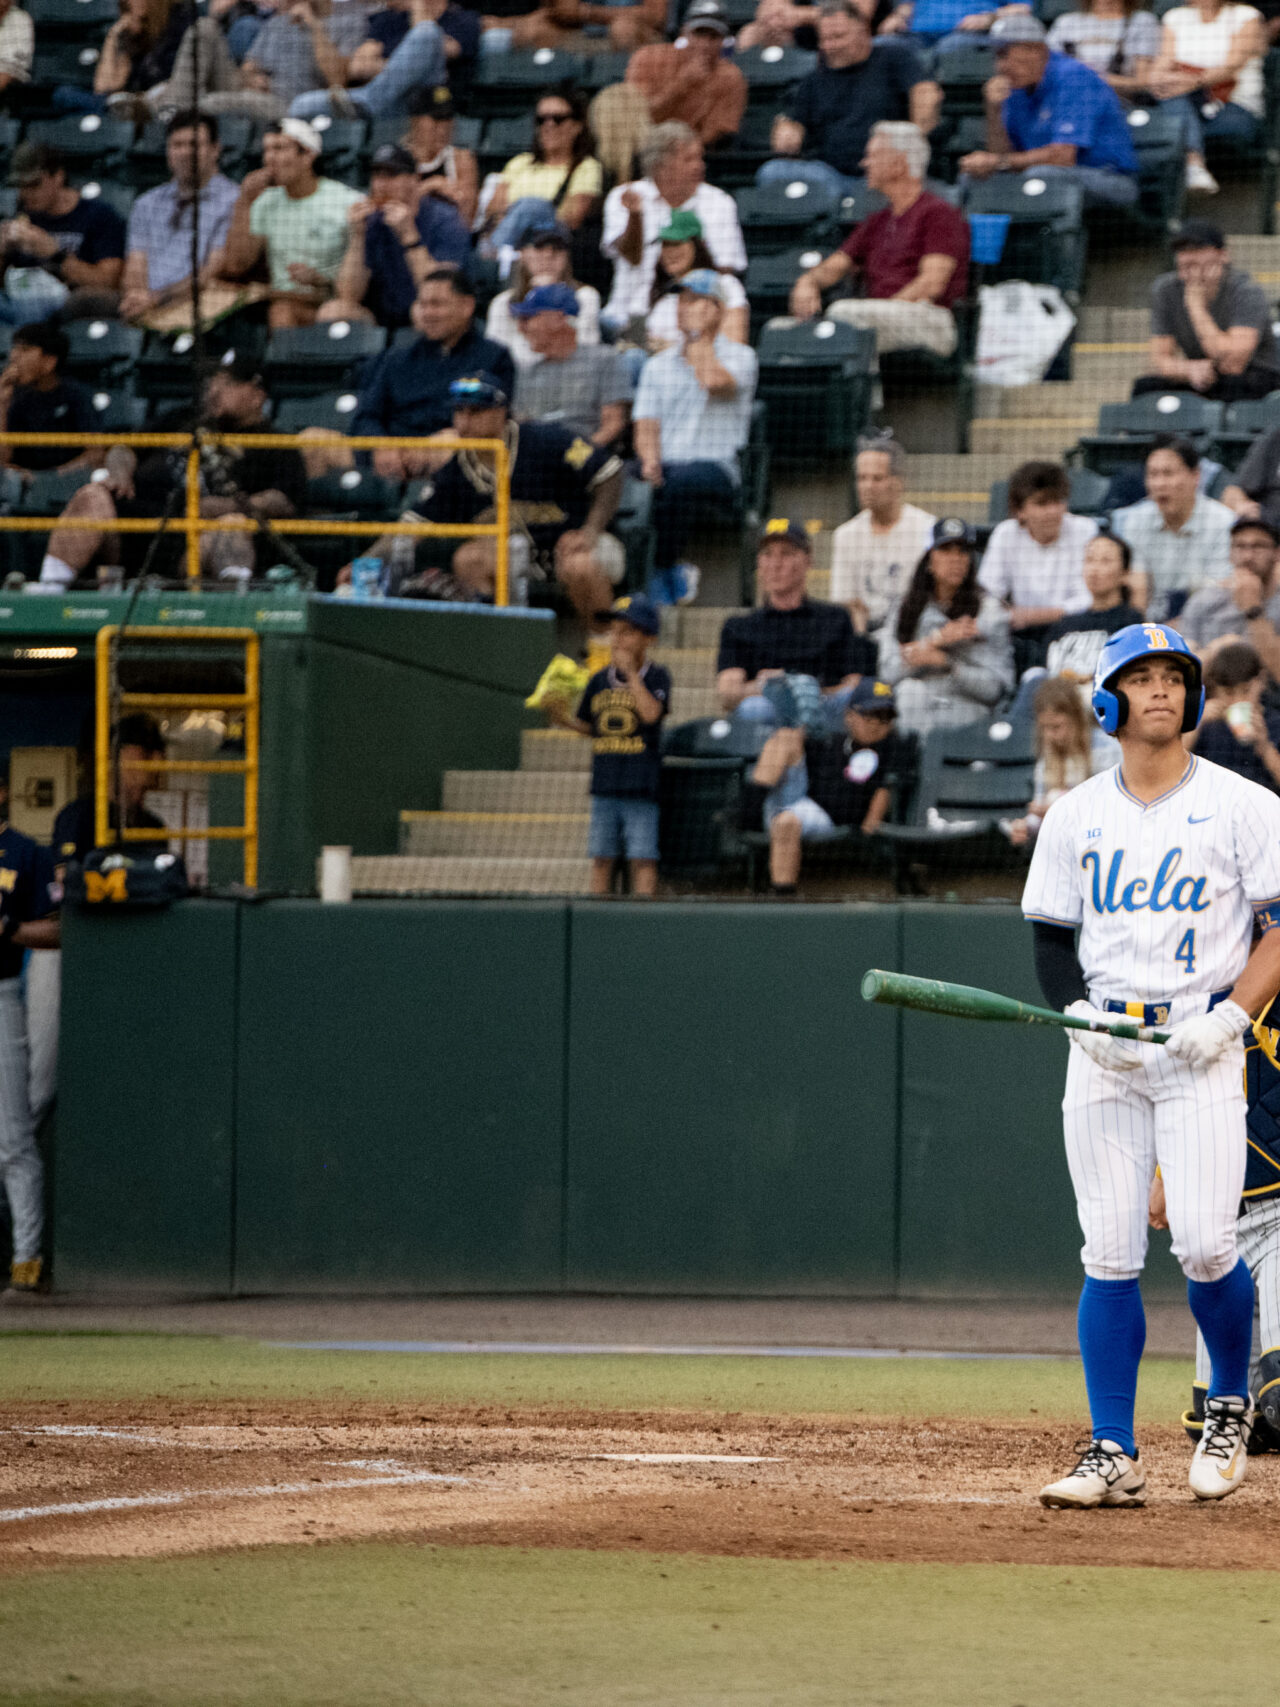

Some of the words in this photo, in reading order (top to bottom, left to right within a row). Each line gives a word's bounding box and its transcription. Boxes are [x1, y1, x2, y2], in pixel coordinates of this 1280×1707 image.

[1143, 628, 1174, 650] B
[84, 868, 128, 903] M
[1081, 846, 1212, 915] Ucla
[1174, 928, 1196, 974] 4
